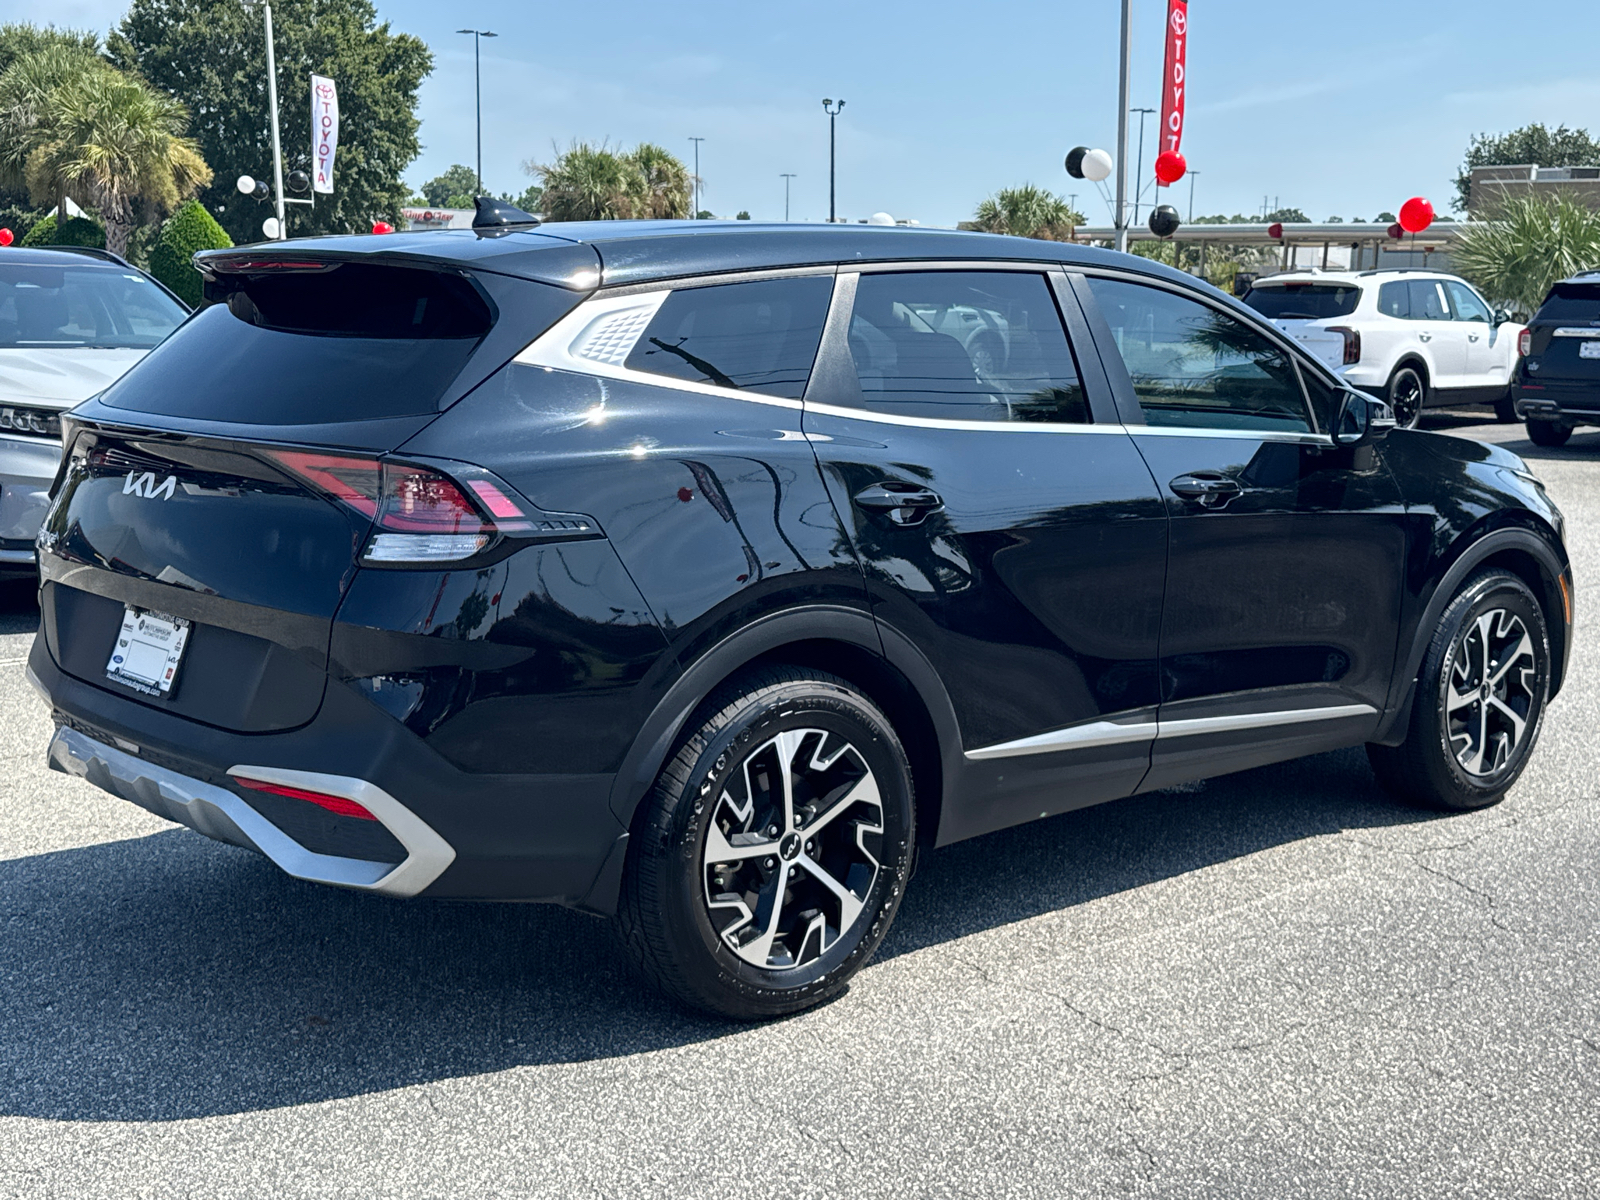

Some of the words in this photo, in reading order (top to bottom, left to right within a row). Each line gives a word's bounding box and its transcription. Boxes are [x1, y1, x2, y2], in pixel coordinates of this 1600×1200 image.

[1167, 39, 1184, 151] TOYOT
[318, 102, 332, 185] TOYOTA
[122, 469, 177, 501] KIA
